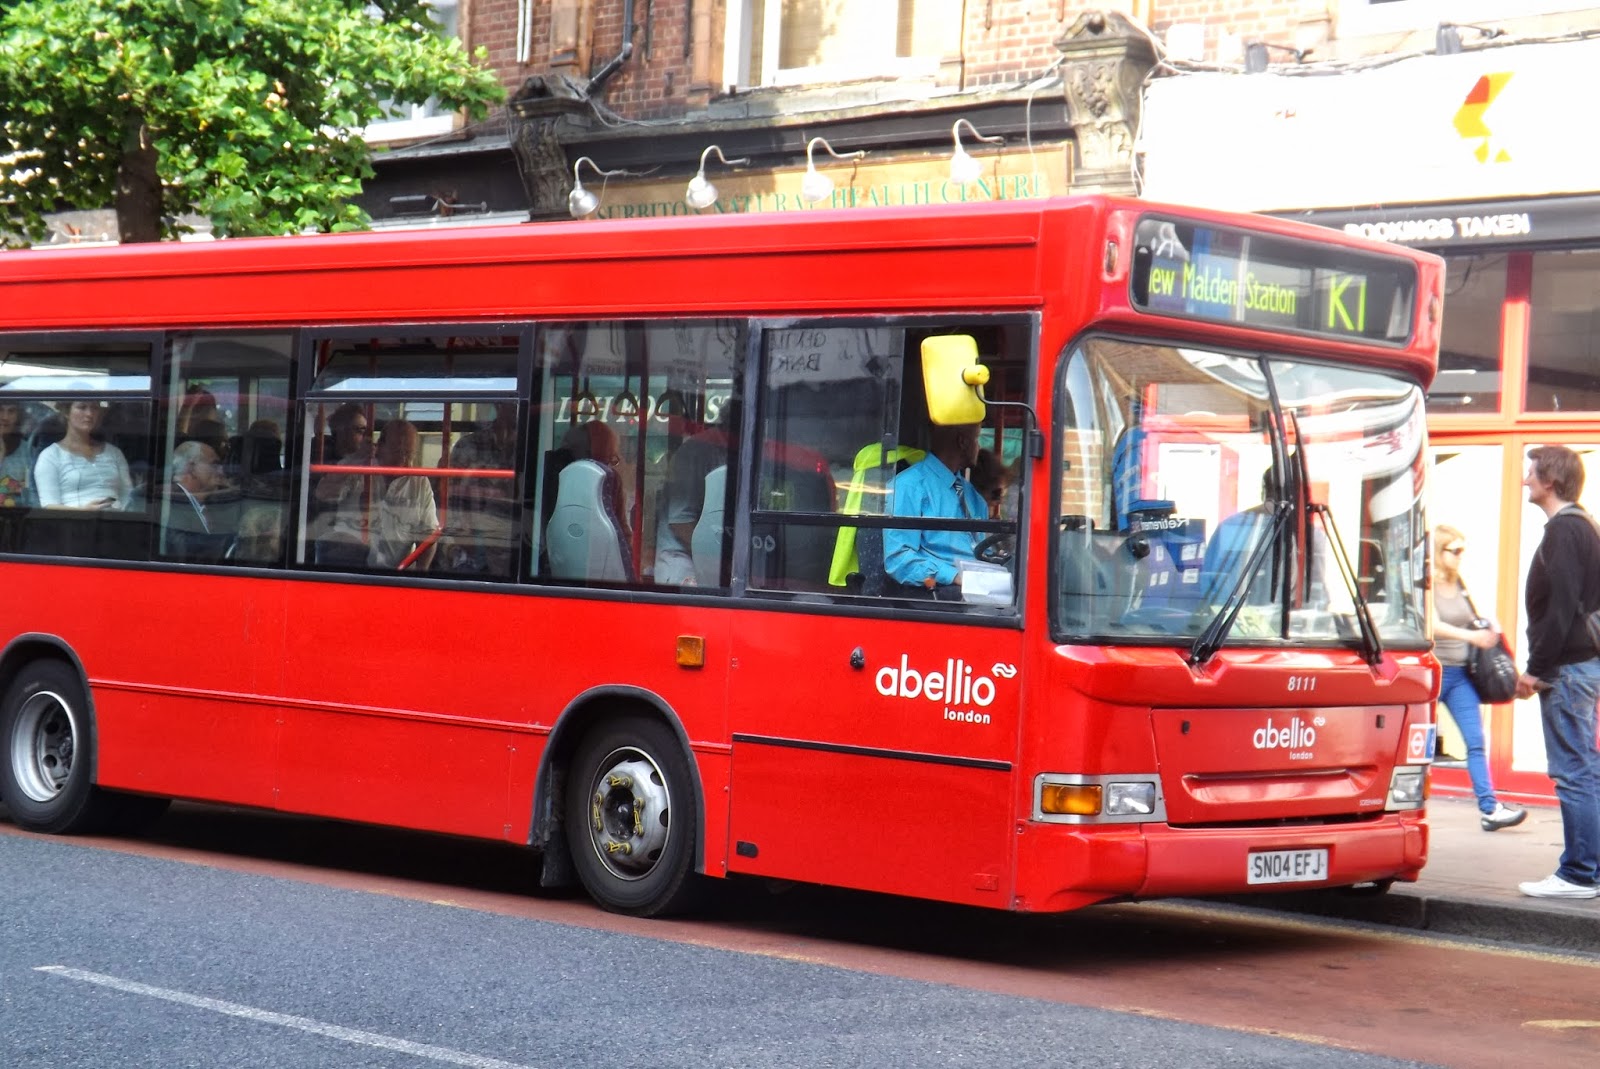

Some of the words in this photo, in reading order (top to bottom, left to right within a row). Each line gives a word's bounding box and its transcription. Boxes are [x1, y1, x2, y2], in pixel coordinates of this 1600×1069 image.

[1457, 213, 1530, 237] TAKEN
[1182, 260, 1238, 305] Malden
[1244, 271, 1296, 316] Station
[875, 653, 996, 707] abellio
[1286, 676, 1317, 692] 8111
[943, 707, 991, 725] london
[1253, 717, 1316, 750] abellio
[1289, 750, 1314, 761] london
[1253, 852, 1292, 879] SN04
[1294, 850, 1322, 876] EFJ
